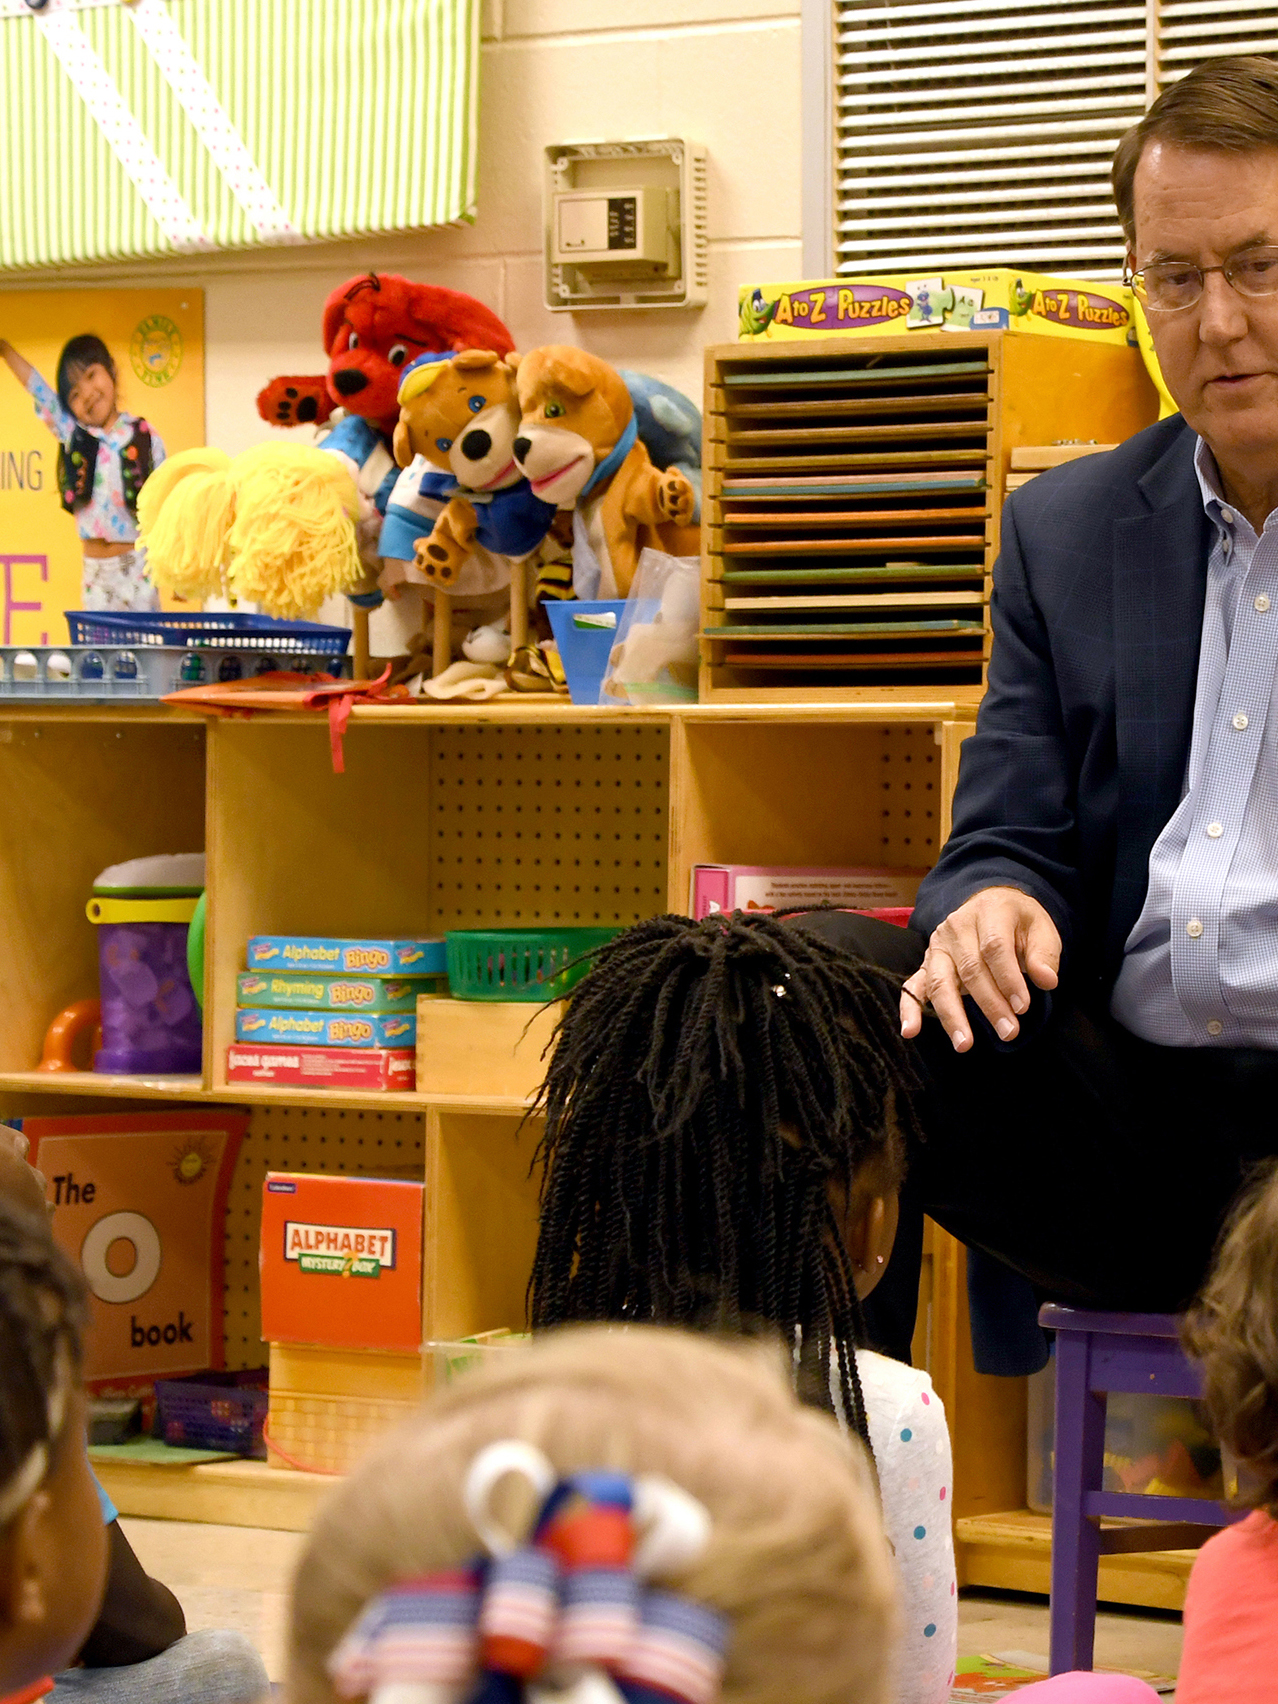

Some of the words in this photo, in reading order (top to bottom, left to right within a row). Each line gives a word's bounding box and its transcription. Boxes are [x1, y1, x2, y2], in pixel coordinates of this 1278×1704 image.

[775, 294, 793, 324] A
[792, 299, 809, 317] to
[809, 292, 827, 324] Z
[837, 288, 911, 321] Puzzles
[1032, 289, 1047, 316] A
[1045, 297, 1057, 312] to
[1057, 293, 1071, 319] Z
[1077, 294, 1129, 326] Puzzles
[0, 450, 43, 491] ING
[0, 554, 48, 645] E
[283, 944, 341, 962] Alphabet
[344, 948, 390, 971] Bingo
[271, 978, 325, 999] Rhyming
[330, 983, 374, 1006] Bingo
[269, 1016, 325, 1033] Alphabet
[328, 1022, 373, 1042] Bingo
[53, 1173, 96, 1205] The
[290, 1228, 389, 1258] ALPHABET
[131, 1311, 194, 1348] book
